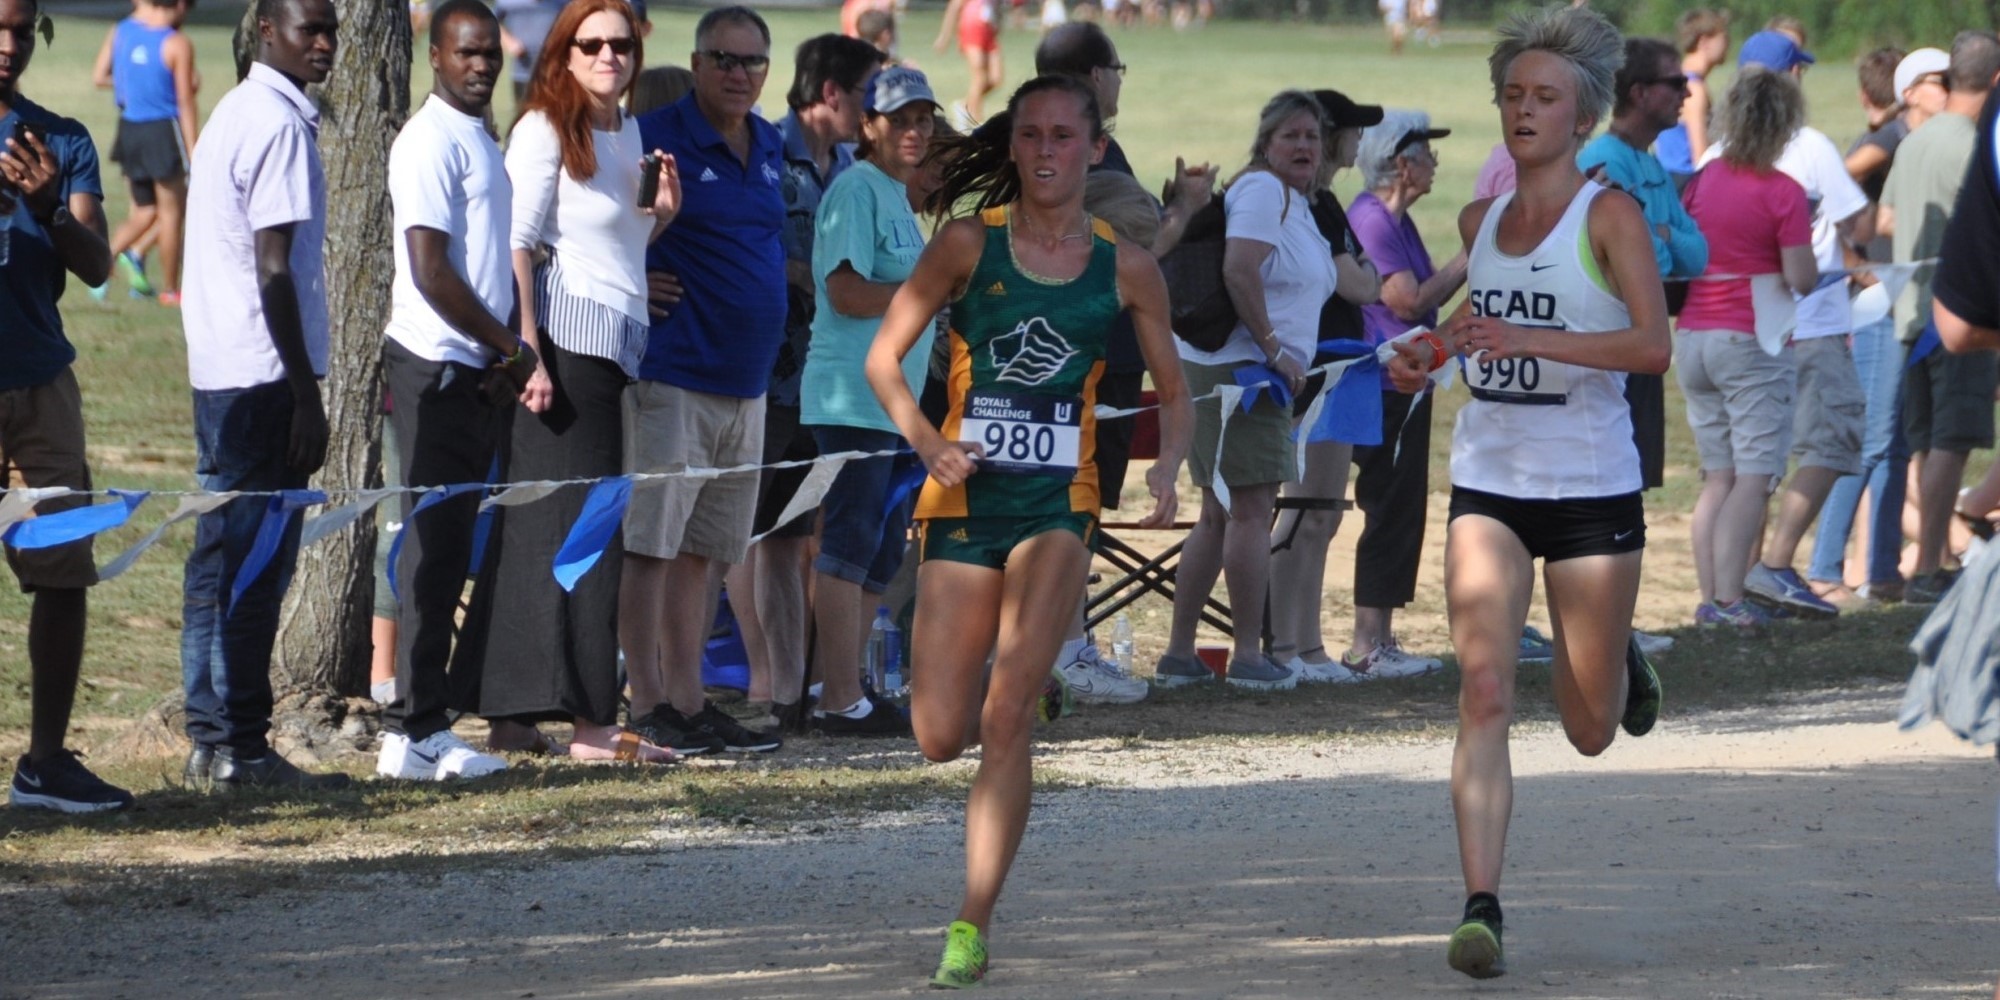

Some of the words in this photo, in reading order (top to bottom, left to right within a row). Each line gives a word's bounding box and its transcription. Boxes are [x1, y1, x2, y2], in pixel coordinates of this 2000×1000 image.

[1471, 289, 1556, 320] SCAD
[1479, 351, 1539, 391] 990
[972, 407, 1032, 420] CHALLENGE
[973, 396, 1012, 408] ROYALS
[985, 421, 1055, 463] 980
